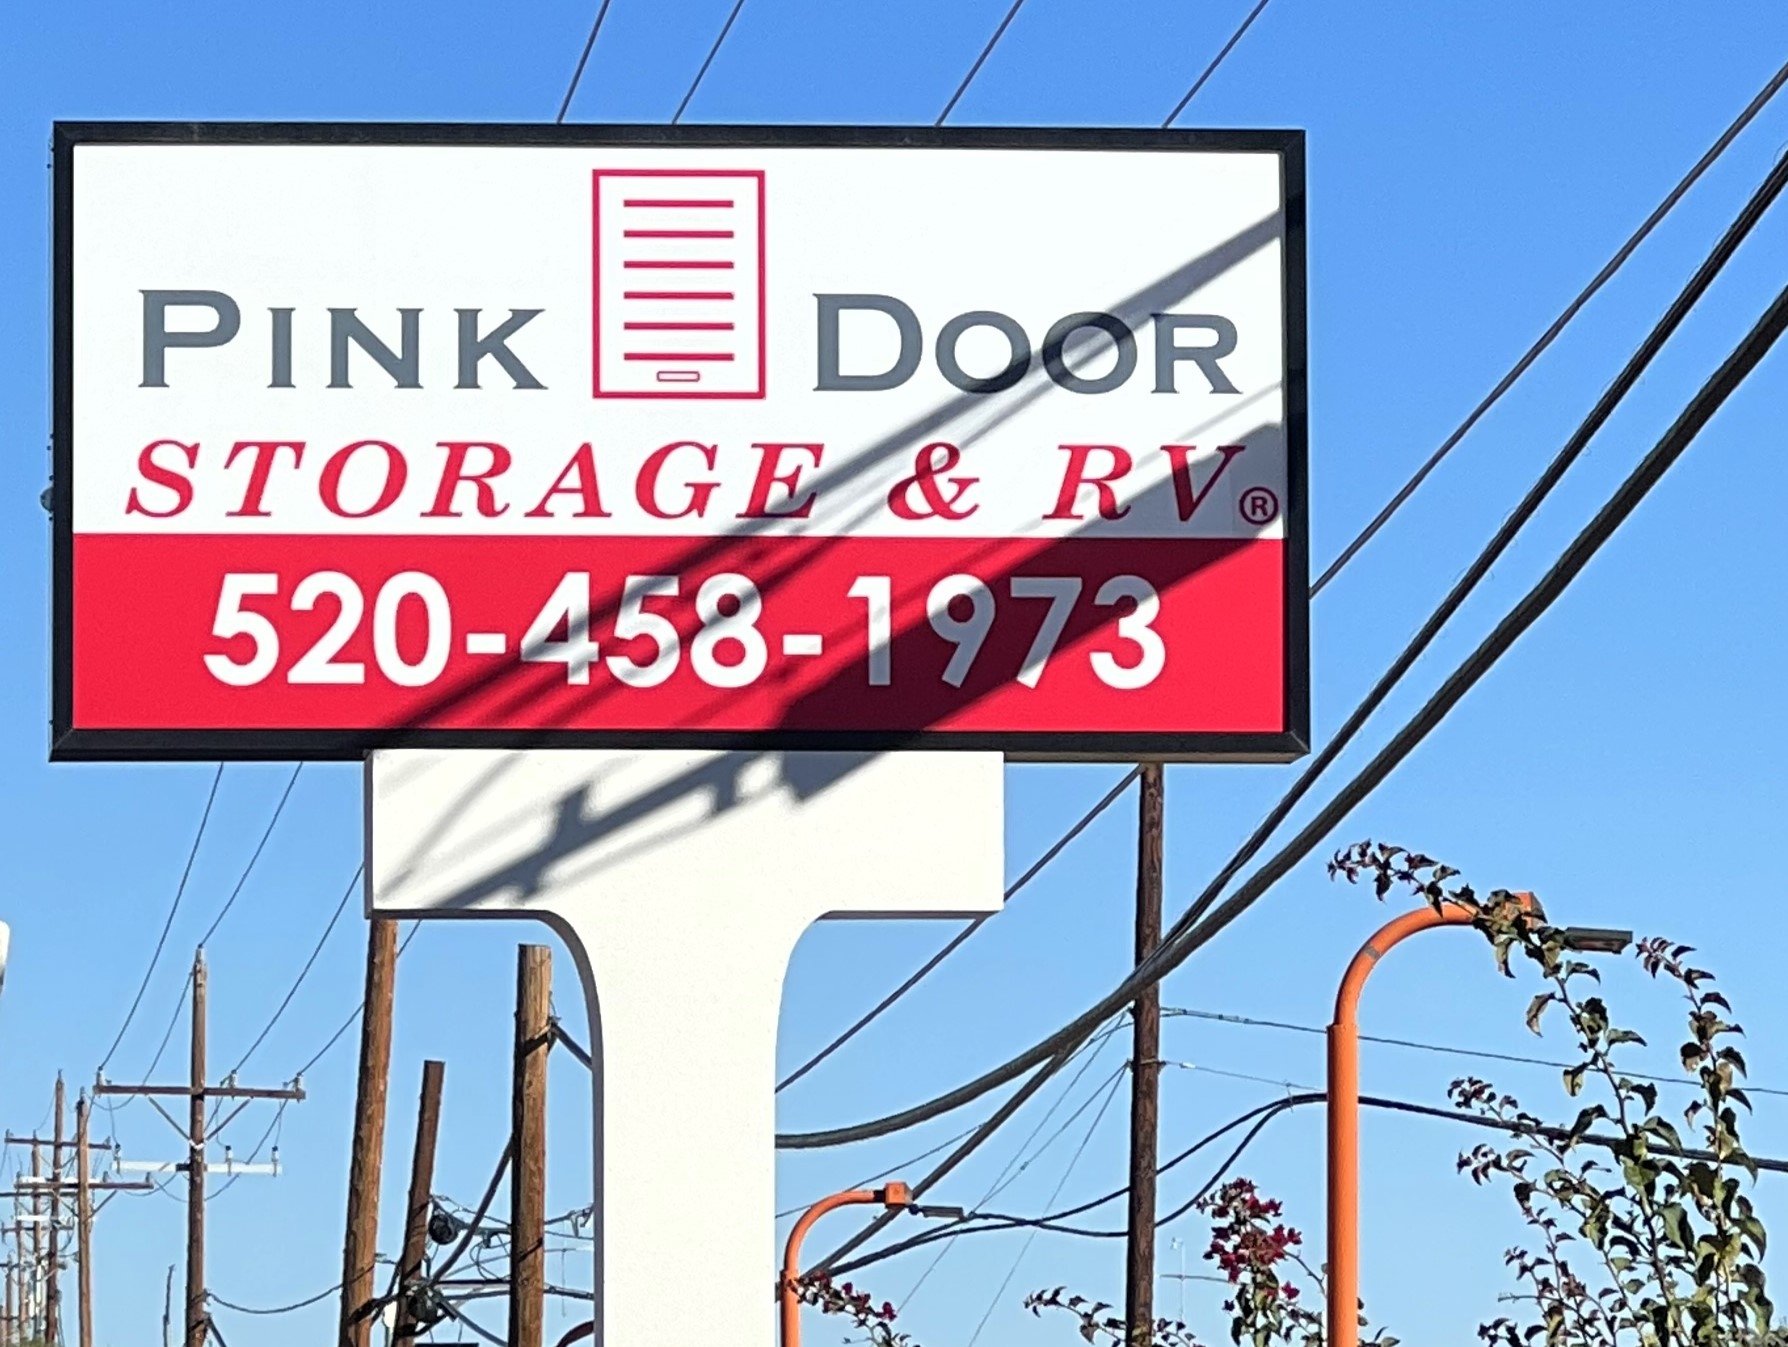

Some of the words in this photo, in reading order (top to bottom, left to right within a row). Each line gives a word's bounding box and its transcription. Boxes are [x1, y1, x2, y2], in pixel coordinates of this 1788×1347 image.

[139, 289, 548, 390] PINK
[812, 293, 1242, 395] DOOR
[125, 440, 825, 521] STORAGE
[887, 441, 979, 521] &
[203, 570, 1167, 690] 520-458-1973
